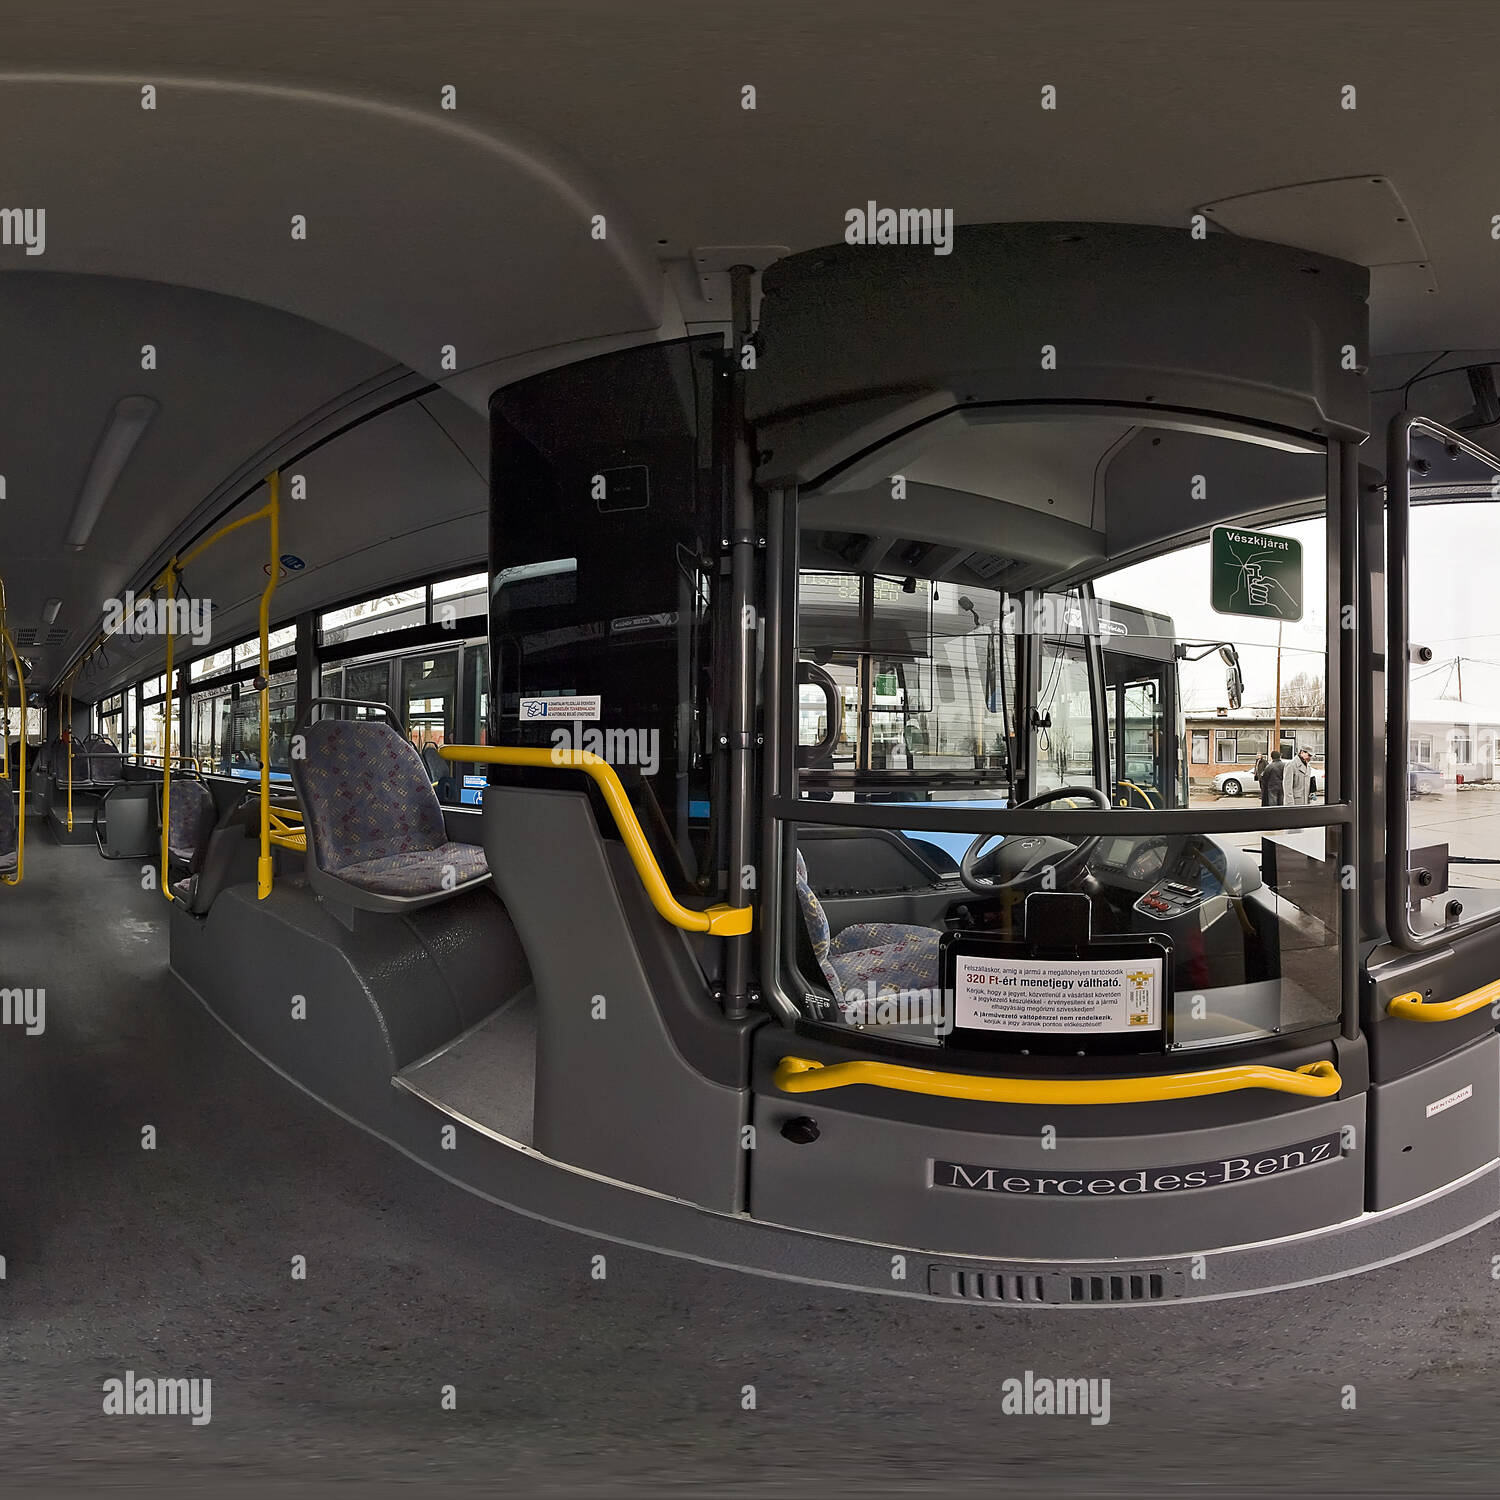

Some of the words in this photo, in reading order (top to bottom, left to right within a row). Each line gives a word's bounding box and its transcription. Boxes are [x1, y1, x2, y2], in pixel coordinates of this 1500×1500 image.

[1226, 531, 1289, 551] Vészkijárat
[967, 974, 986, 984] 320
[989, 975, 1017, 986] Ft-ért
[1020, 977, 1074, 990] menetjegy
[1077, 977, 1122, 988] váltható.
[950, 1141, 1331, 1195] Mercedes-Benz
